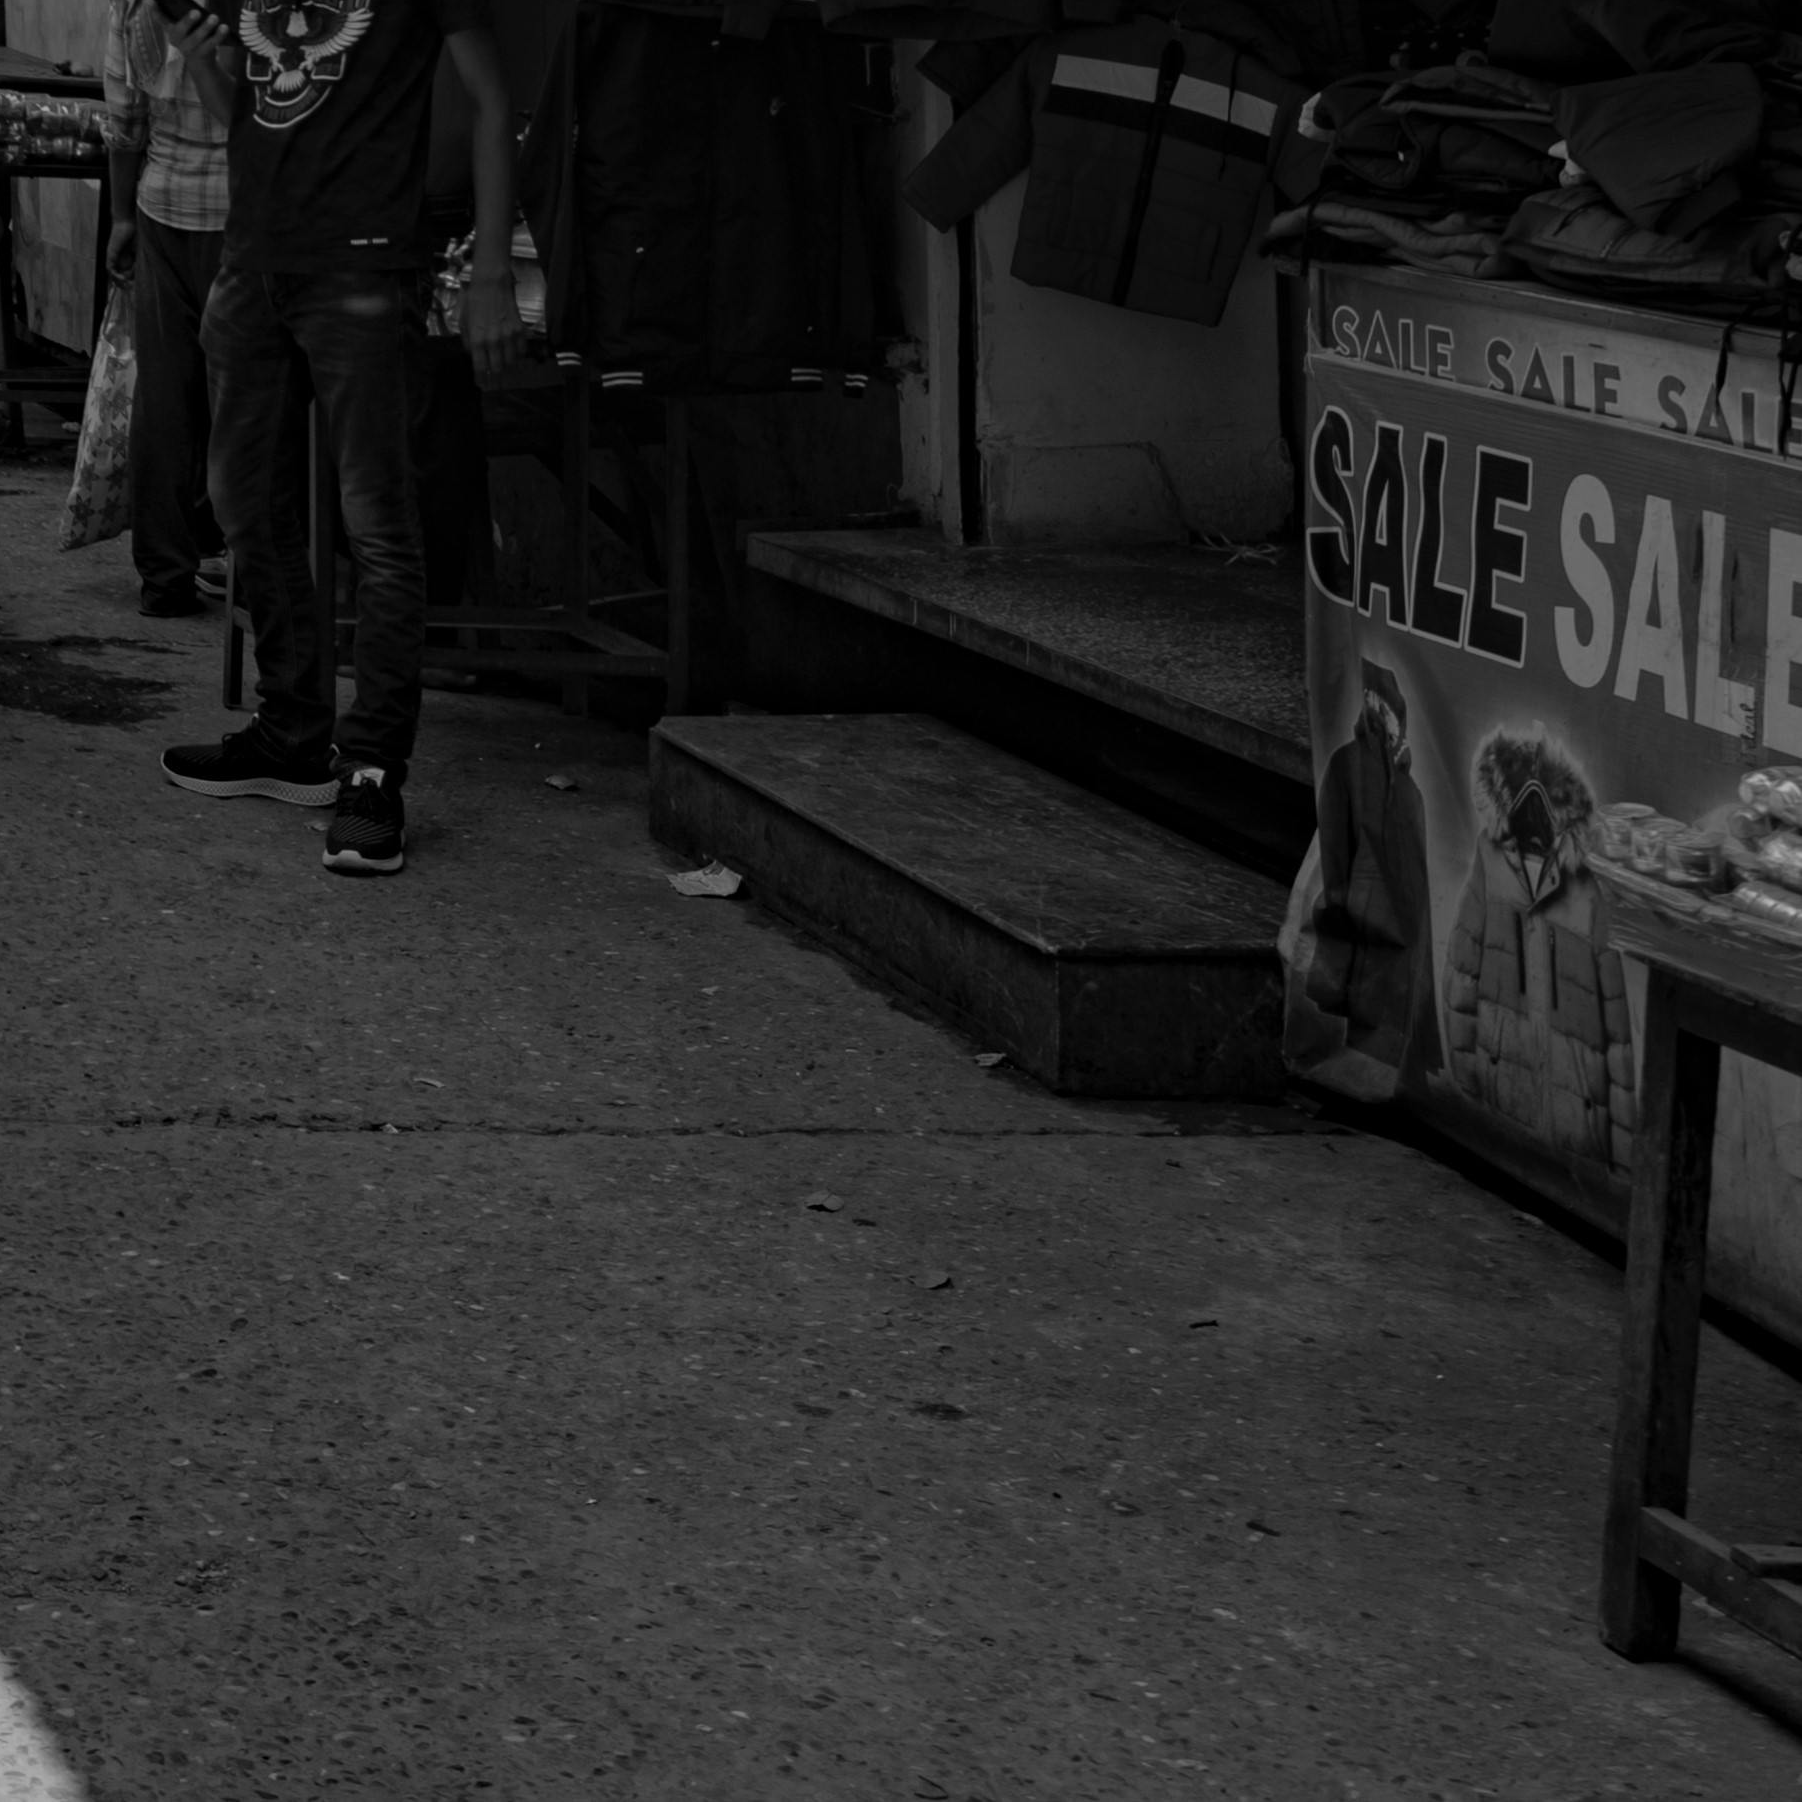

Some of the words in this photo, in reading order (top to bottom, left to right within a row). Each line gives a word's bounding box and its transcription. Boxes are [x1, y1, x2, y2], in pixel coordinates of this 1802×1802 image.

[1332, 305, 1456, 382] SALE
[1485, 338, 1623, 419] SALE
[1306, 405, 1533, 668] SALE
[1553, 473, 1802, 760] SALE
